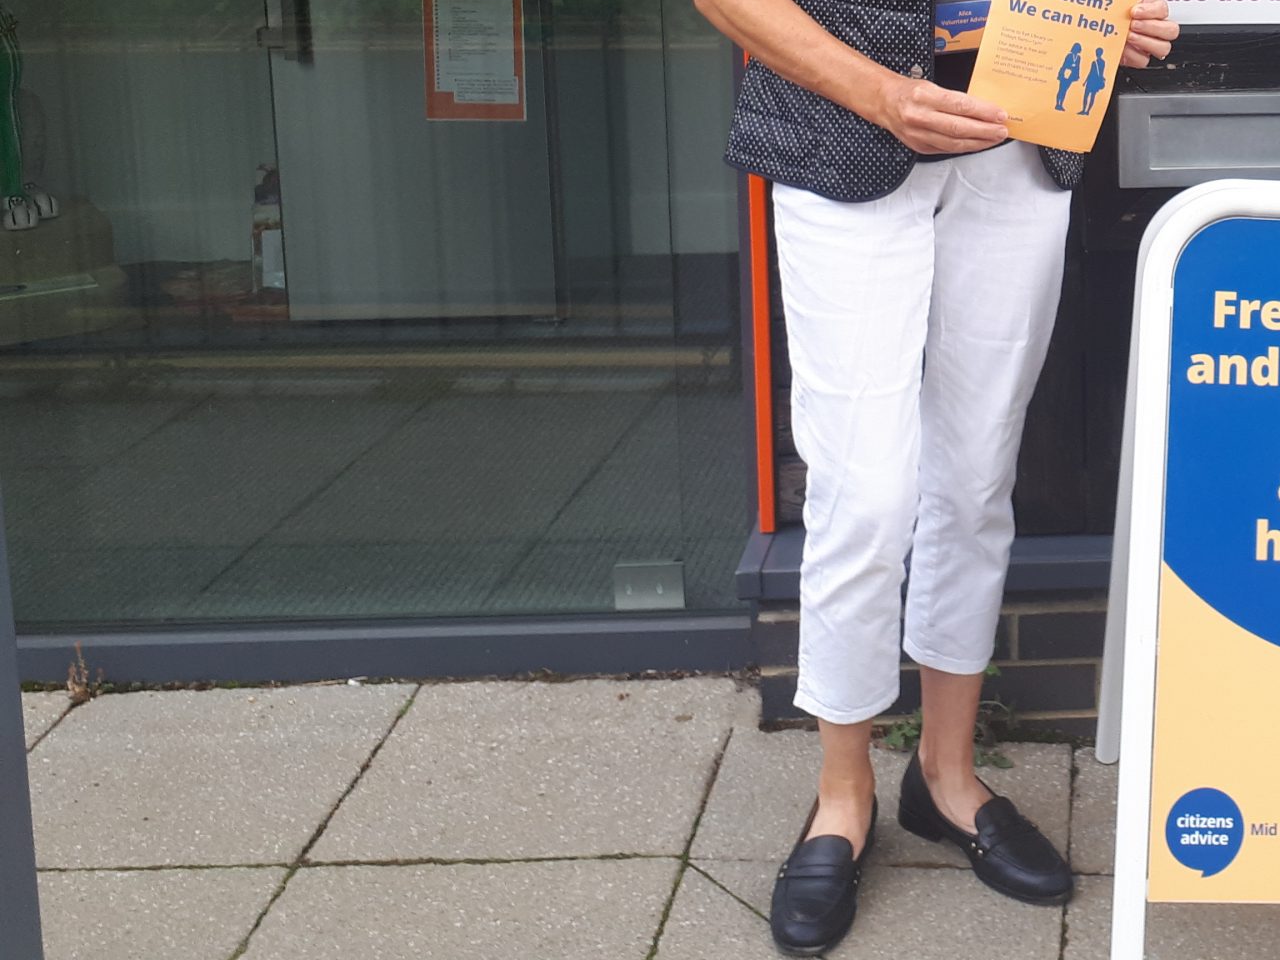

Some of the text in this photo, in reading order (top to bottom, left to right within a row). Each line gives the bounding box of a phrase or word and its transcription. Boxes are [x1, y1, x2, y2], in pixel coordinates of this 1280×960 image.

[1042, 8, 1073, 25] can
[1077, 11, 1119, 37] help.
[1186, 347, 1280, 387] and
[1176, 813, 1234, 830] citizens
[1250, 822, 1278, 837] Mid
[1180, 830, 1230, 846] advice
